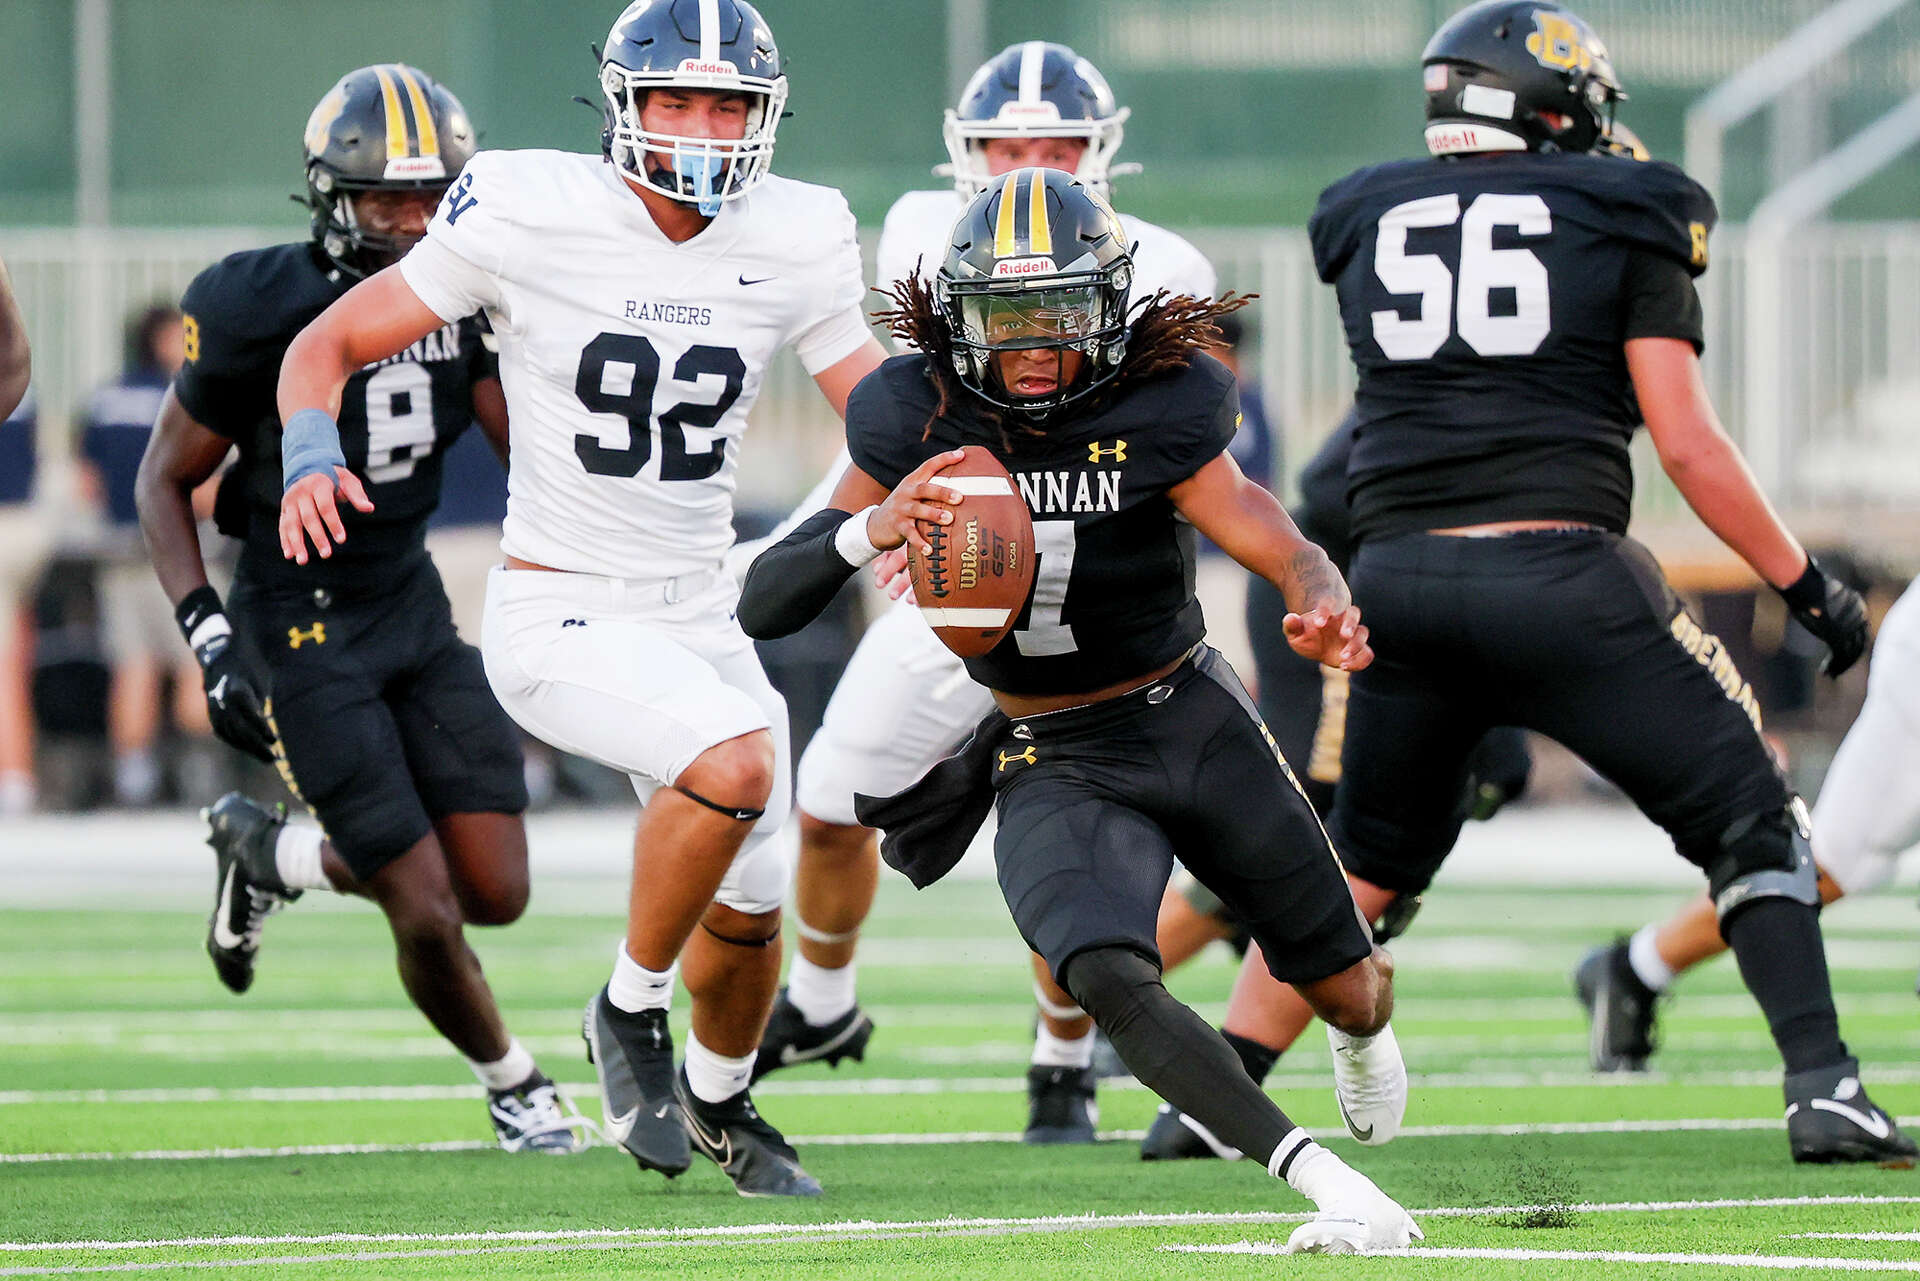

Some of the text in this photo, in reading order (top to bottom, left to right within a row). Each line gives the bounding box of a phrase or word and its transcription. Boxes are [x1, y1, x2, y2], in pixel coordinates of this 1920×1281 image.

[999, 260, 1049, 275] Riddell
[1371, 193, 1553, 361] 56
[624, 300, 712, 326] RANGERS
[364, 360, 437, 485] 8
[574, 332, 747, 481] 92
[1014, 470, 1122, 513] NNAN
[959, 520, 978, 590] Wilson
[992, 529, 1005, 578] GST
[1008, 541, 1018, 570] NCAA
